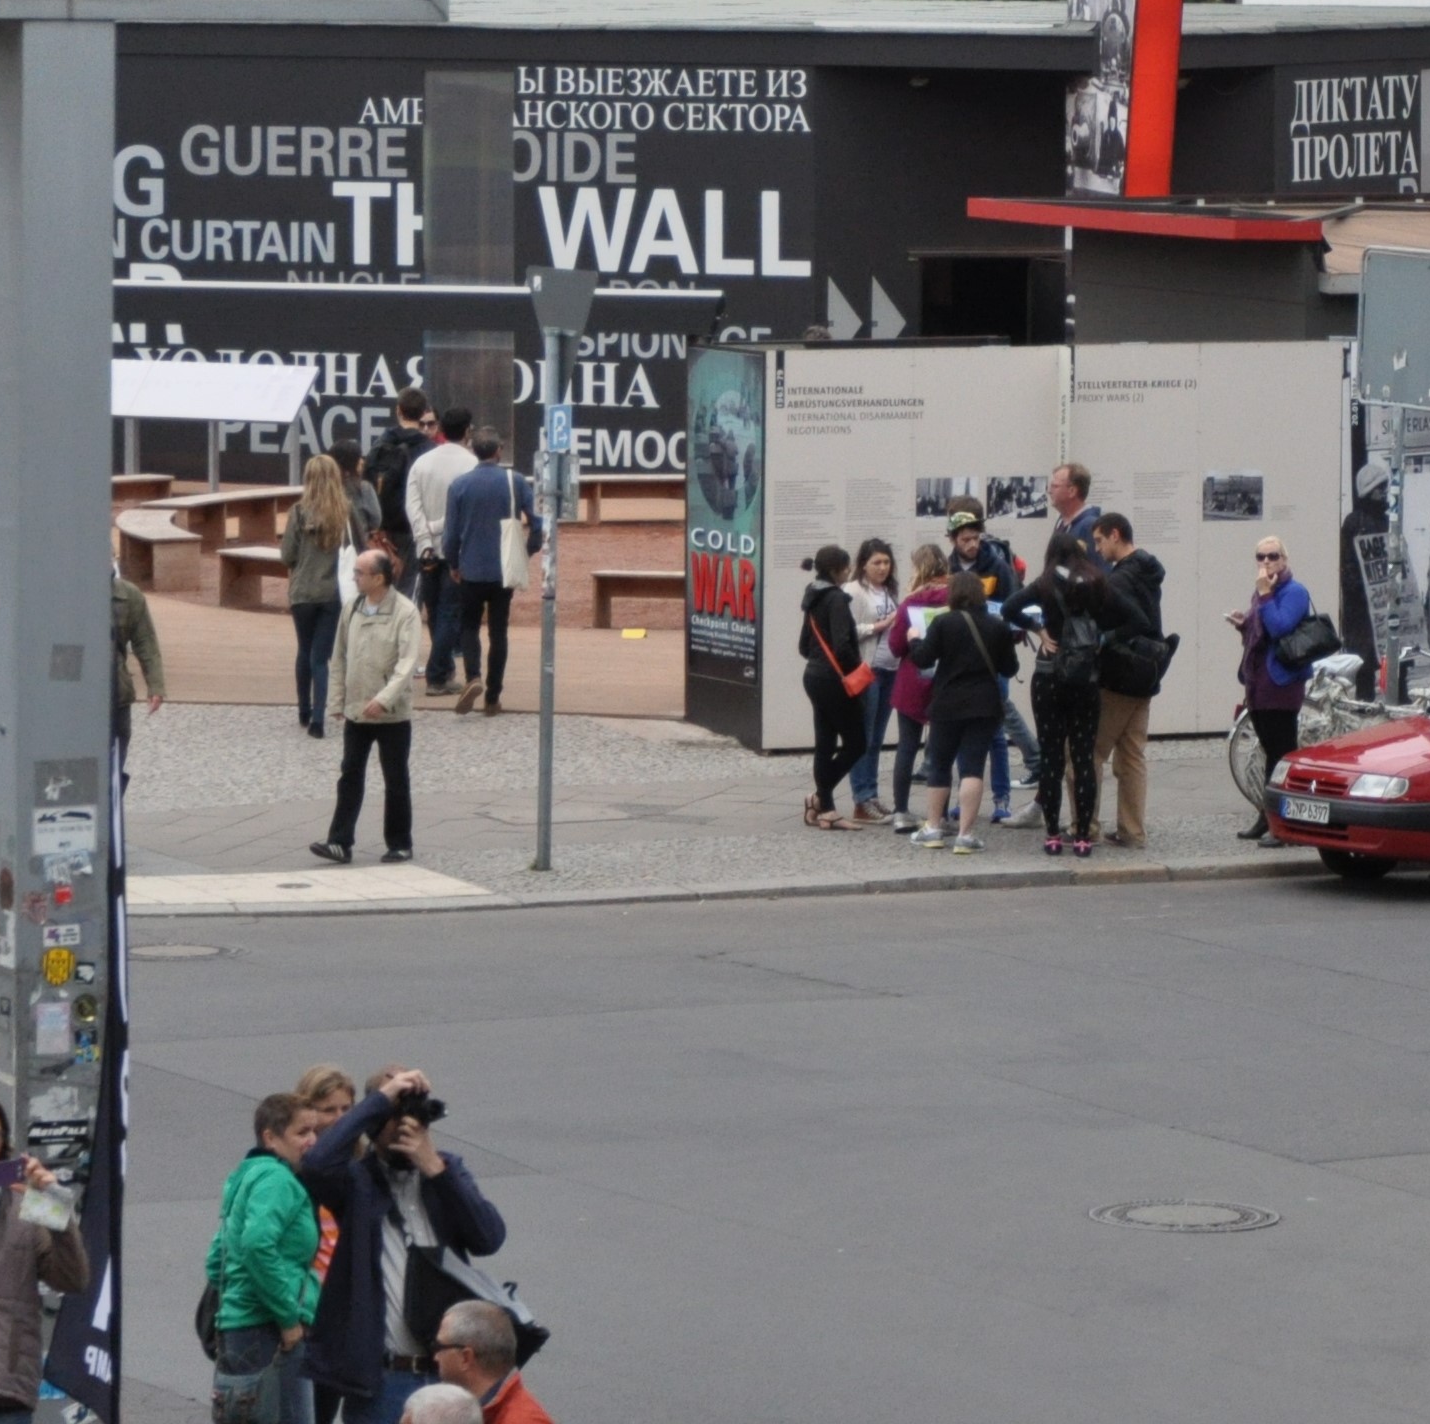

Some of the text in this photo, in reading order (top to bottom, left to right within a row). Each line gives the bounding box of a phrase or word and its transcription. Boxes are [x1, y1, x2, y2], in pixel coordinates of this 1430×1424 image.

[555, 66, 756, 99] ВЫЕЗЖАЕТЕ
[766, 69, 807, 100] ИЗ
[662, 100, 812, 133] СЕКТОРА
[180, 124, 409, 178] GUERRE
[140, 218, 335, 264] CURTAIN
[538, 186, 813, 278] WALL
[787, 385, 864, 395] INTERNATIONALE
[787, 398, 925, 409] ABRÜSTUNGSVERHANDLUNGEN
[1076, 393, 1104, 403] PROXY
[1106, 393, 1131, 403] WARS
[787, 410, 925, 422] INTERNATIONAL DISARMAMENT
[787, 425, 852, 436] NEGOTIATIONS
[690, 527, 755, 555] COLD
[690, 550, 757, 623] WAR
[690, 614, 756, 636] Checkpoint Charlie
